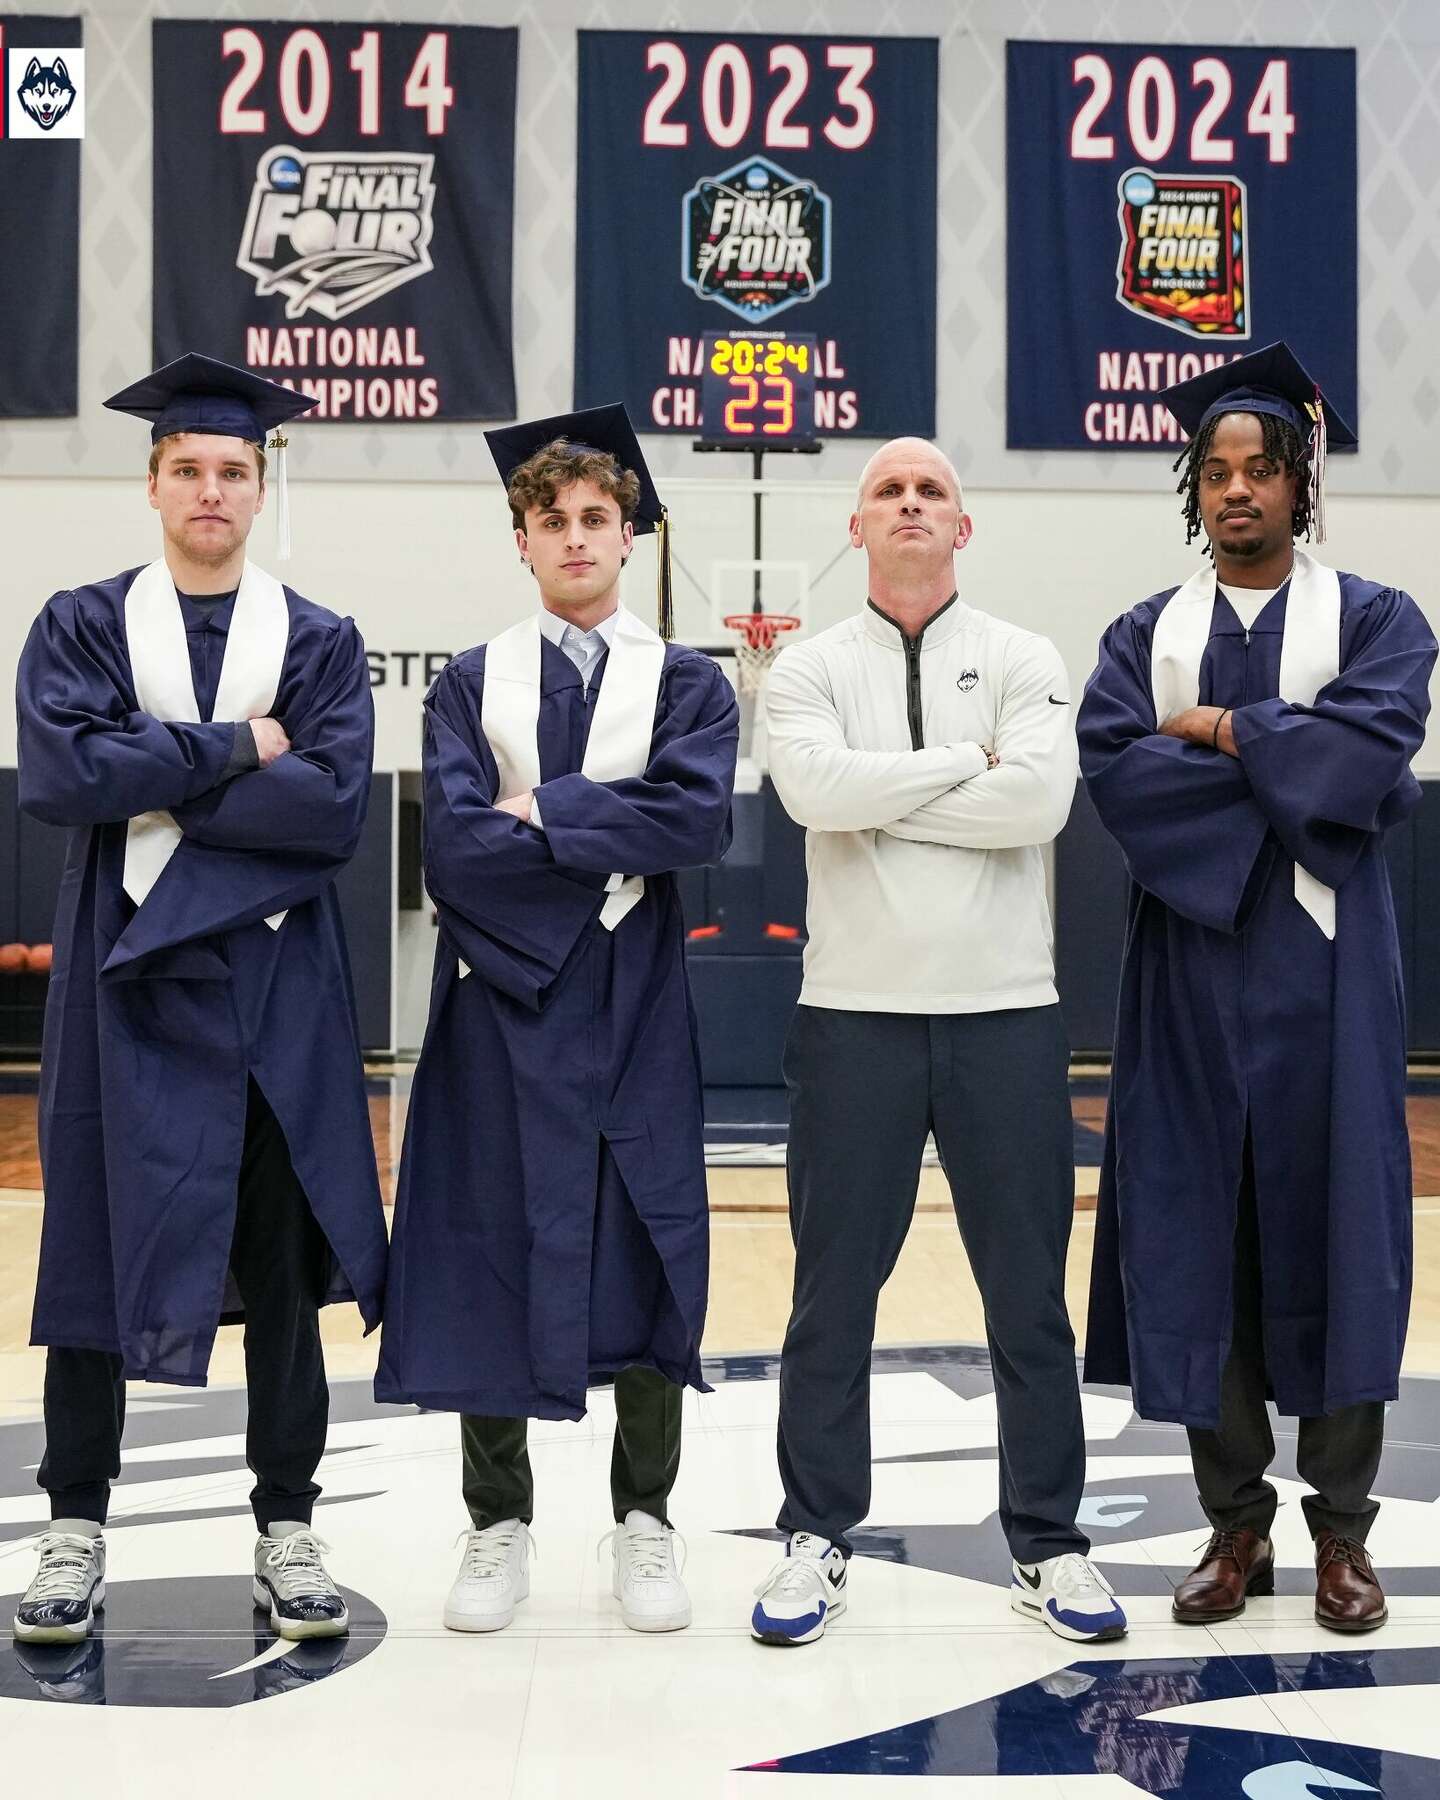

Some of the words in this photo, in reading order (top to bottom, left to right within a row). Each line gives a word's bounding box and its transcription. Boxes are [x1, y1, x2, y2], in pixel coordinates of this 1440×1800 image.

[220, 27, 454, 136] 2014
[643, 41, 874, 150] 2023
[1071, 54, 1295, 163] 2024
[302, 164, 420, 209] FINAL
[251, 192, 421, 260] FOUR
[709, 198, 805, 236] FINAL
[1138, 205, 1220, 238] FINAL
[717, 235, 812, 274] FOUR
[1138, 237, 1220, 272] FOUR
[247, 327, 425, 367] NATIONAL
[711, 340, 808, 375] 20:24
[1099, 351, 1245, 391] NATIO
[266, 378, 439, 417] MPIONS
[725, 376, 793, 433] 23
